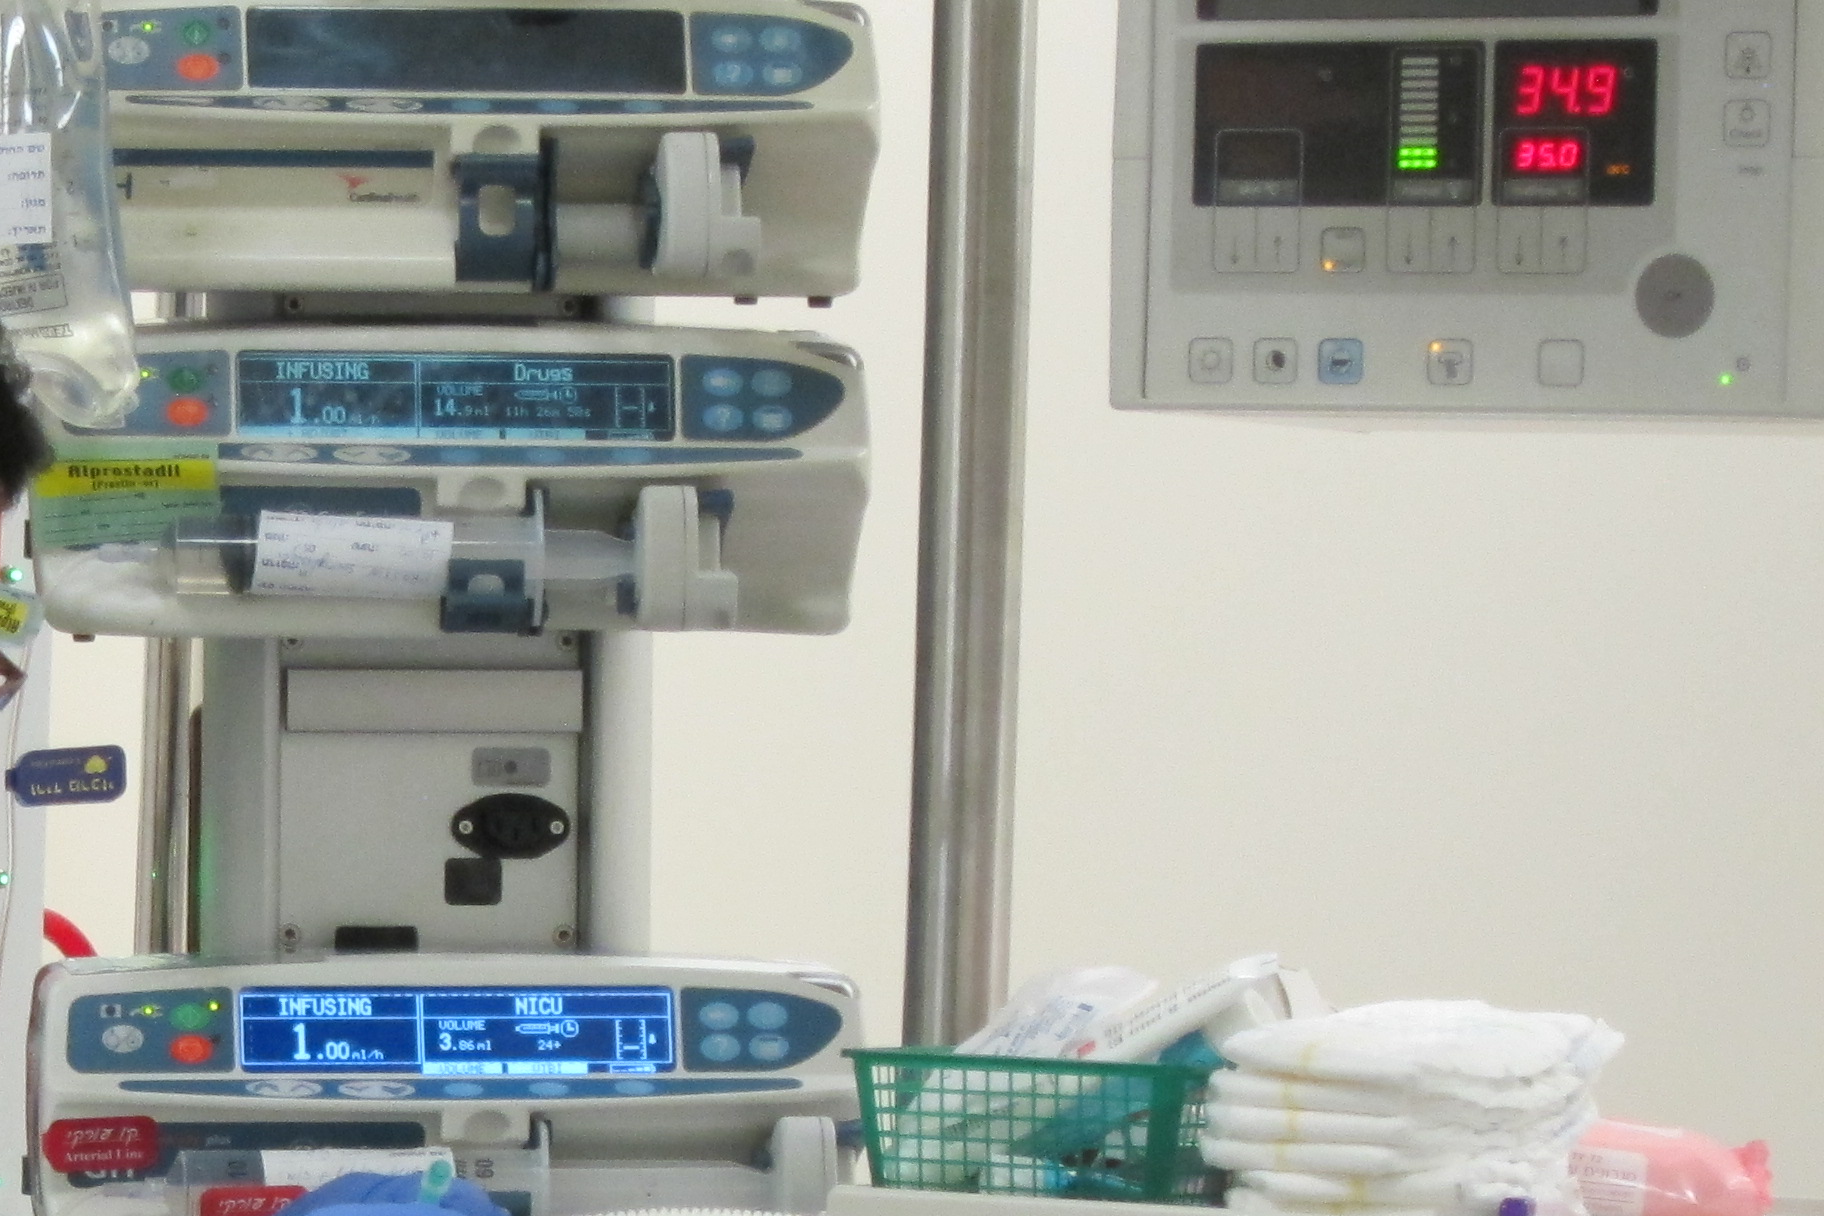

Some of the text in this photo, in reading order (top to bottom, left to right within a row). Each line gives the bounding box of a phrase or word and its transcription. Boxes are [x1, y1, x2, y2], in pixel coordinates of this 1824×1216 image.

[1515, 65, 1618, 115] 34.9
[275, 361, 370, 380] INFUSING
[514, 363, 574, 382] Drugs
[67, 463, 181, 479] Alprostadil
[278, 997, 372, 1016] INFUSING
[514, 997, 563, 1015] NICU
[438, 1020, 487, 1031] VOLUME
[537, 1039, 562, 1051] 24+
[119, 1127, 139, 1147] קו
[65, 1149, 146, 1162] Arterial Line
